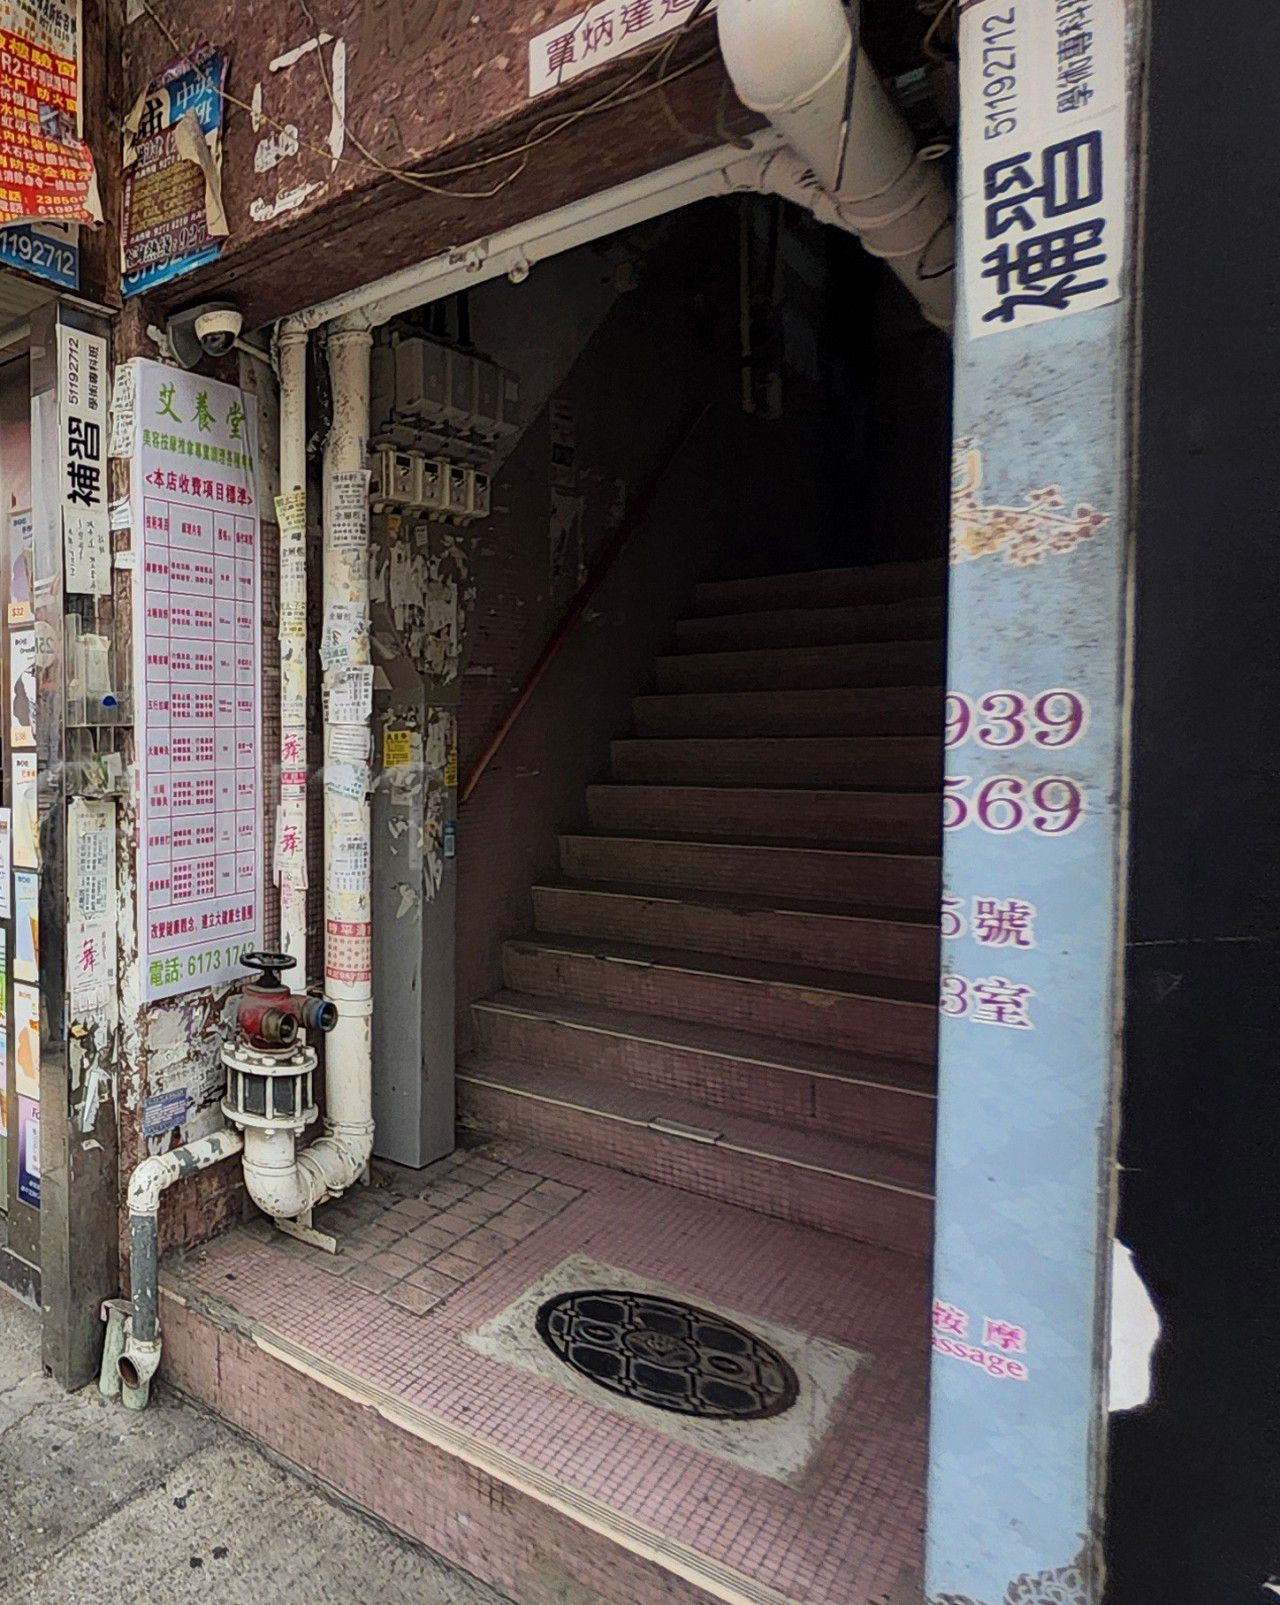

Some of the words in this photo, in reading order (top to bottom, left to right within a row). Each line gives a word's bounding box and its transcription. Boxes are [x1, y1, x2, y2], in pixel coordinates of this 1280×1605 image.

[982, 7, 1017, 140] 51192712
[982, 130, 1108, 322] 補習
[68, 337, 80, 405] 51192712
[155, 381, 246, 440] 艾養堂
[68, 416, 101, 506] 補習
[188, 949, 221, 978] 6173
[930, 1335, 1024, 1377] ssage
